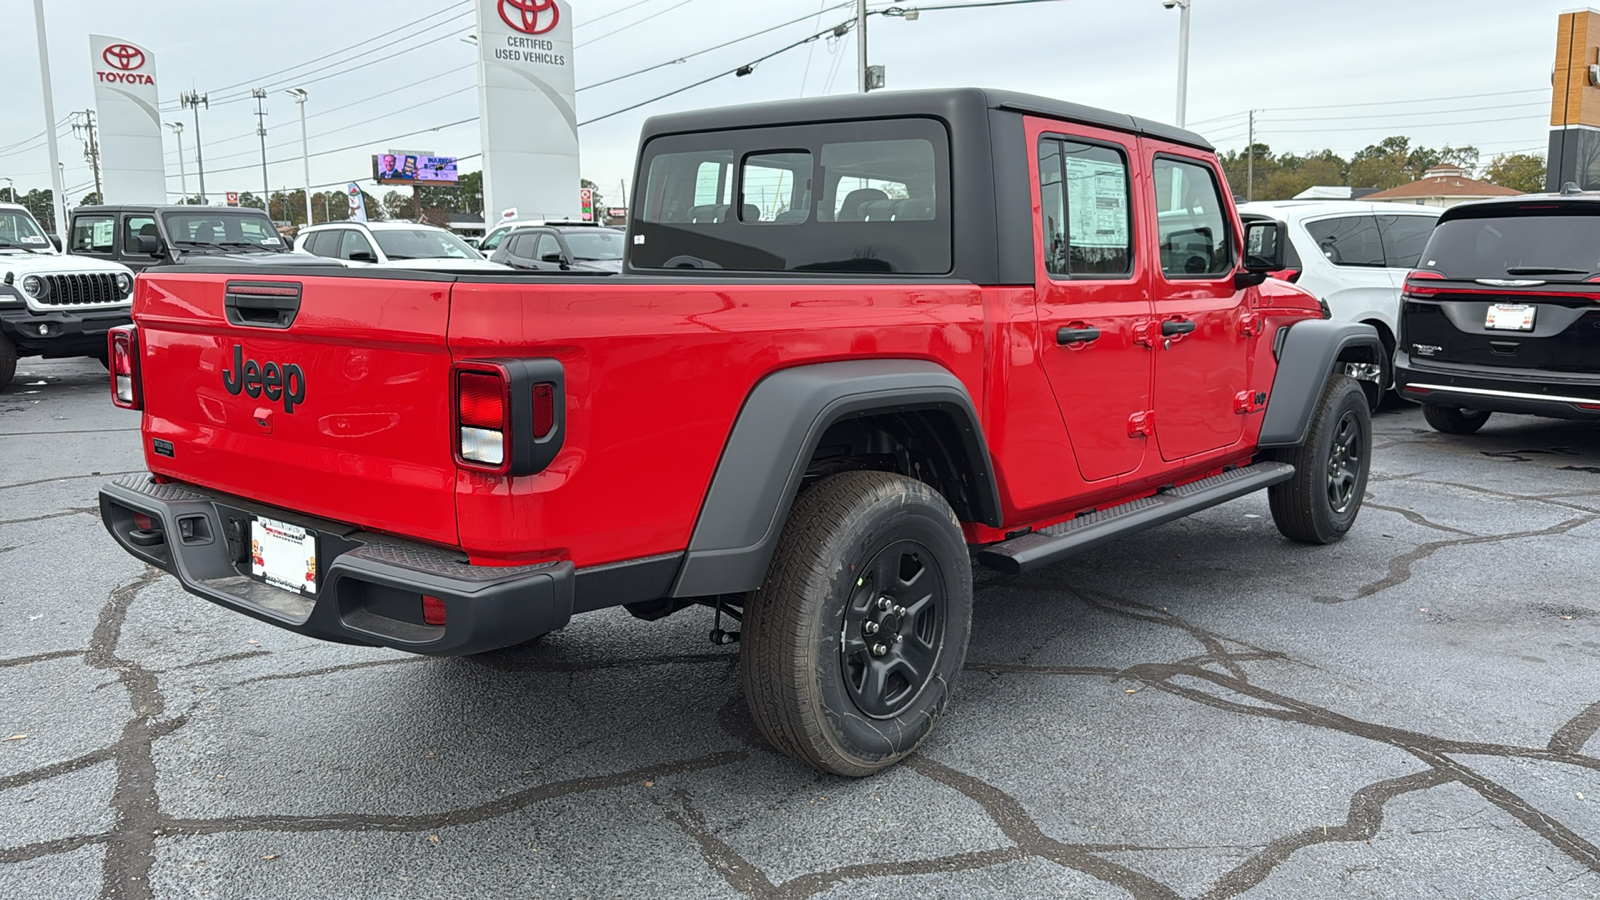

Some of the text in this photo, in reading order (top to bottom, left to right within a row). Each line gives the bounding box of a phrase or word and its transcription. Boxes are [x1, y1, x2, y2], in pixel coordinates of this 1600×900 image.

[508, 36, 553, 51] CERTIFIED
[495, 48, 565, 66] USED VEHICLES
[97, 72, 154, 85] TOYOTA
[223, 344, 305, 414] Jeep
